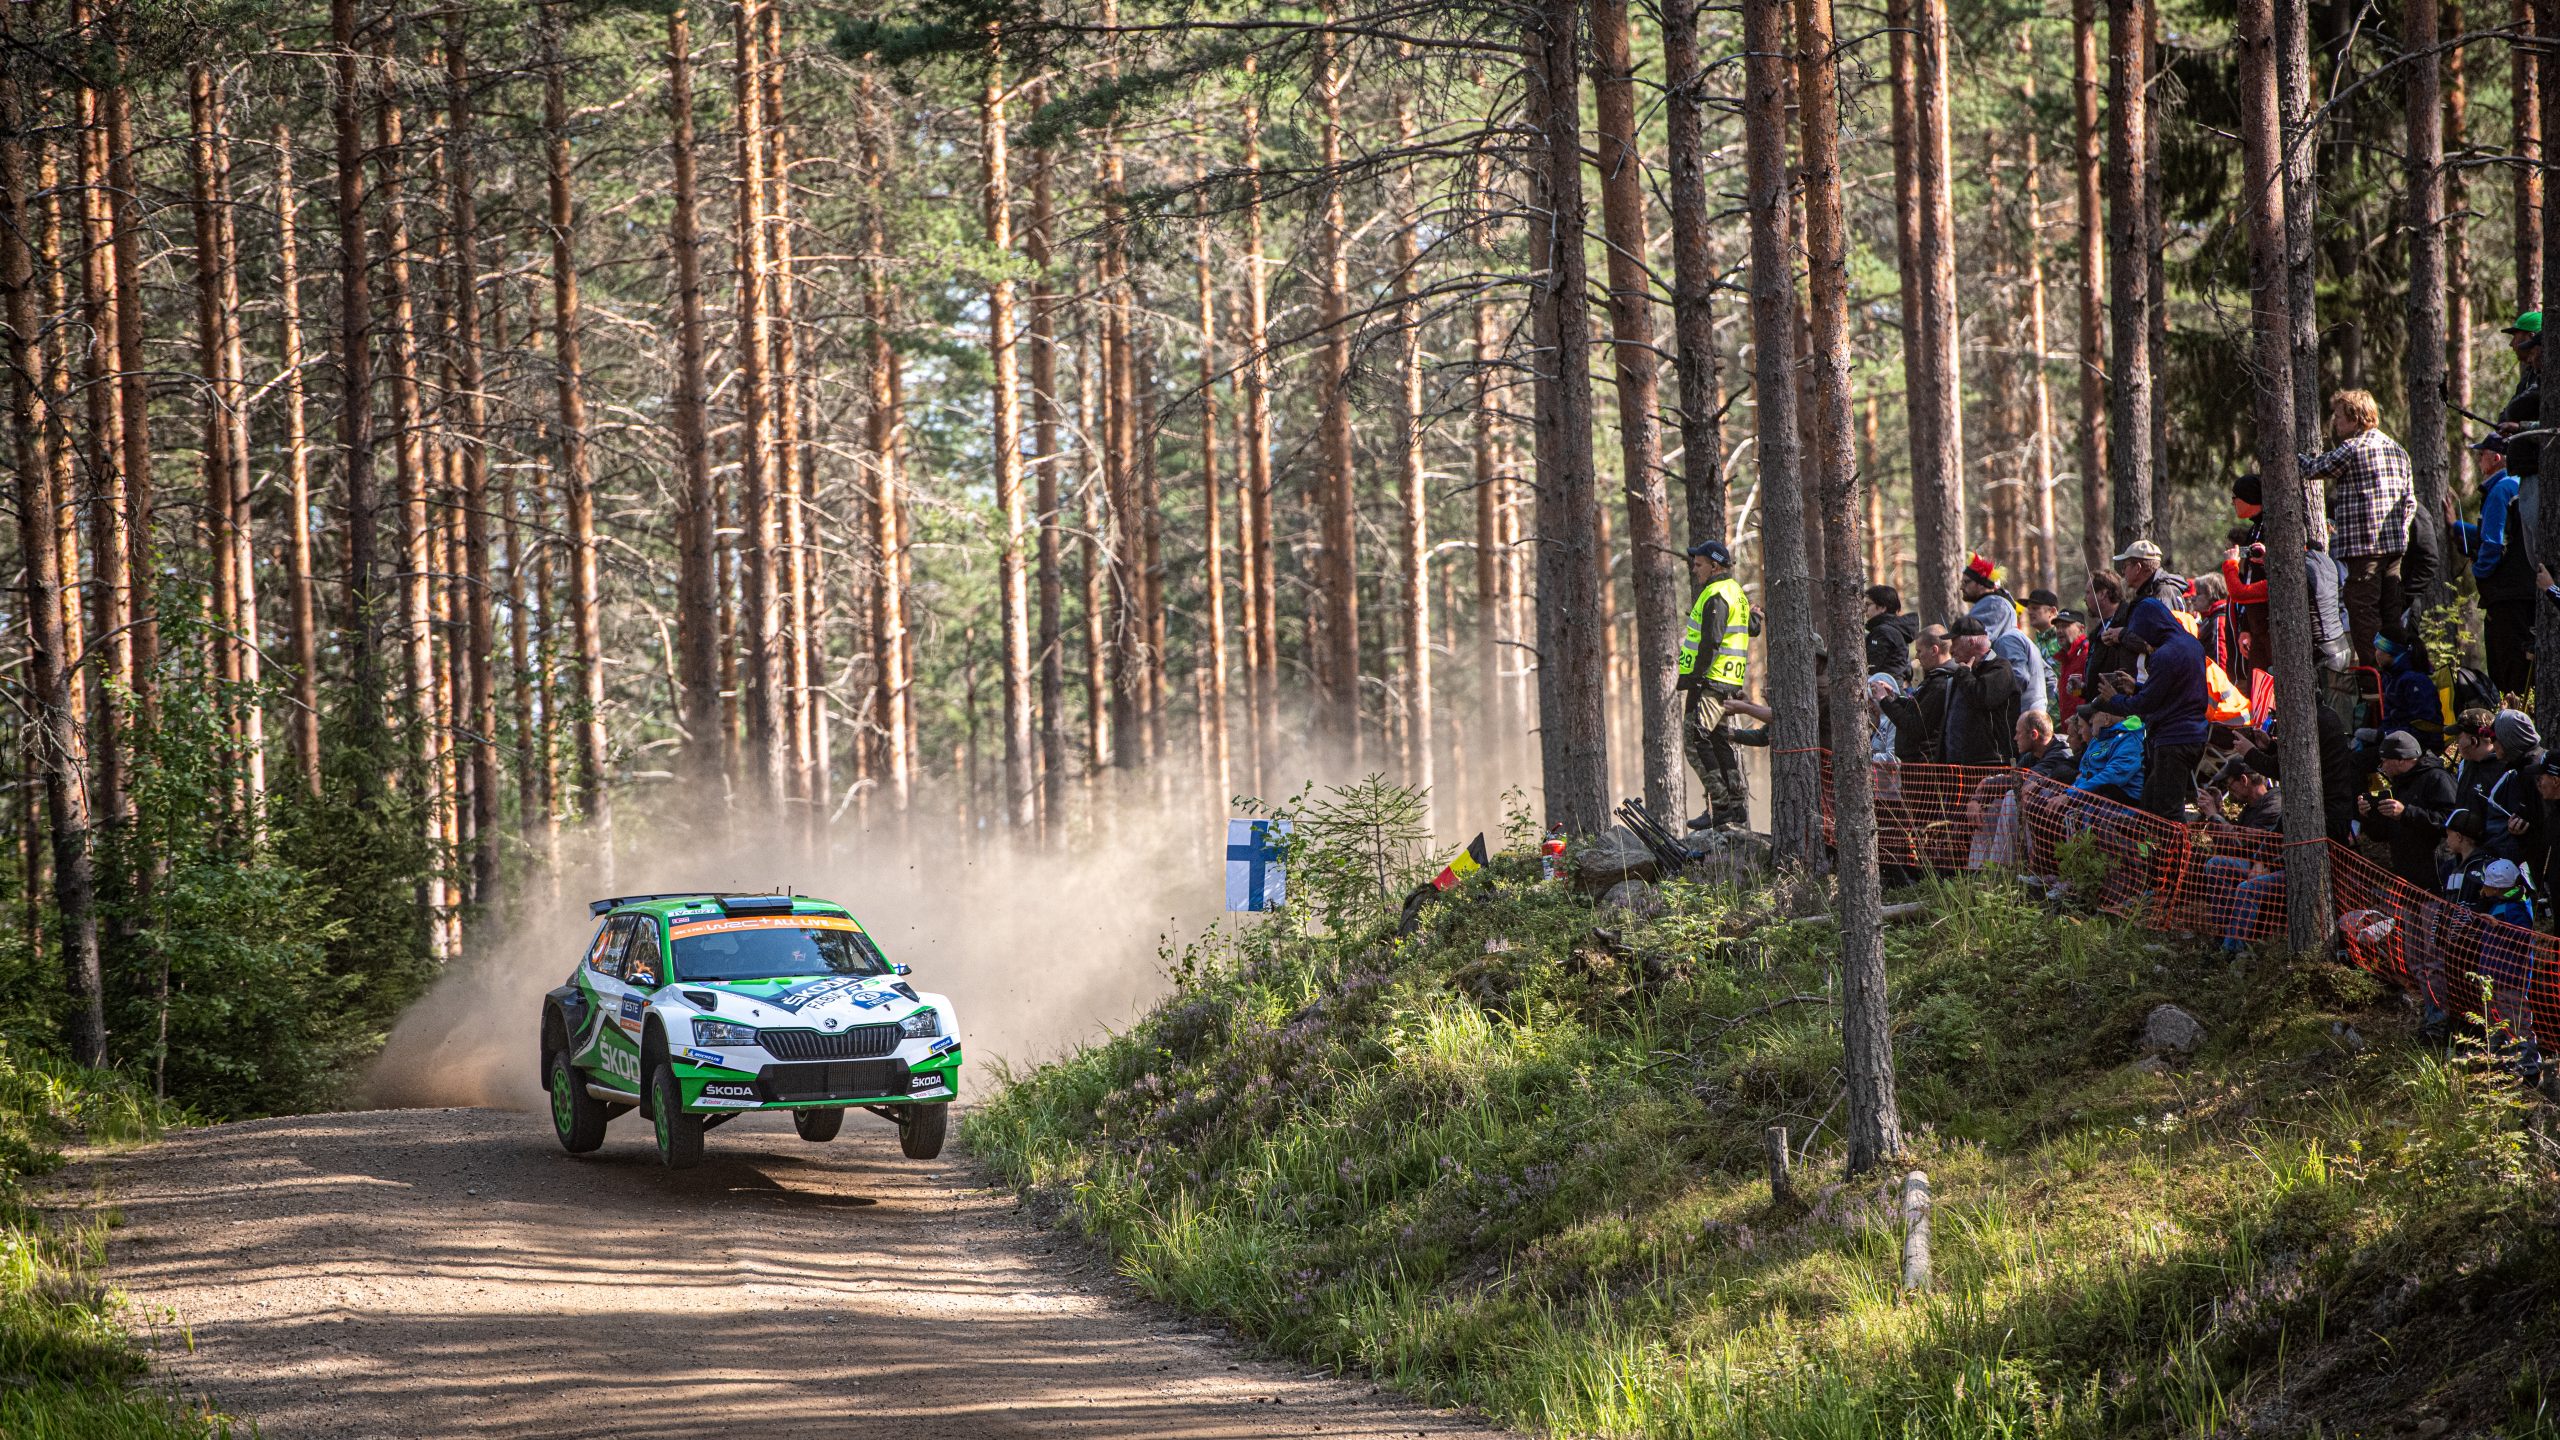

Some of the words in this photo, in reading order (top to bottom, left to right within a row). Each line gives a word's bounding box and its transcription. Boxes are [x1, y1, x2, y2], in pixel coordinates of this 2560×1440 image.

[774, 918, 799, 926] ALL
[781, 977, 860, 1006] ŠKODA
[843, 978, 881, 996] R5
[695, 1053, 721, 1062] MICHELIN
[912, 1075, 942, 1088] ŠKODA
[706, 1084, 754, 1096] ŠKODA
